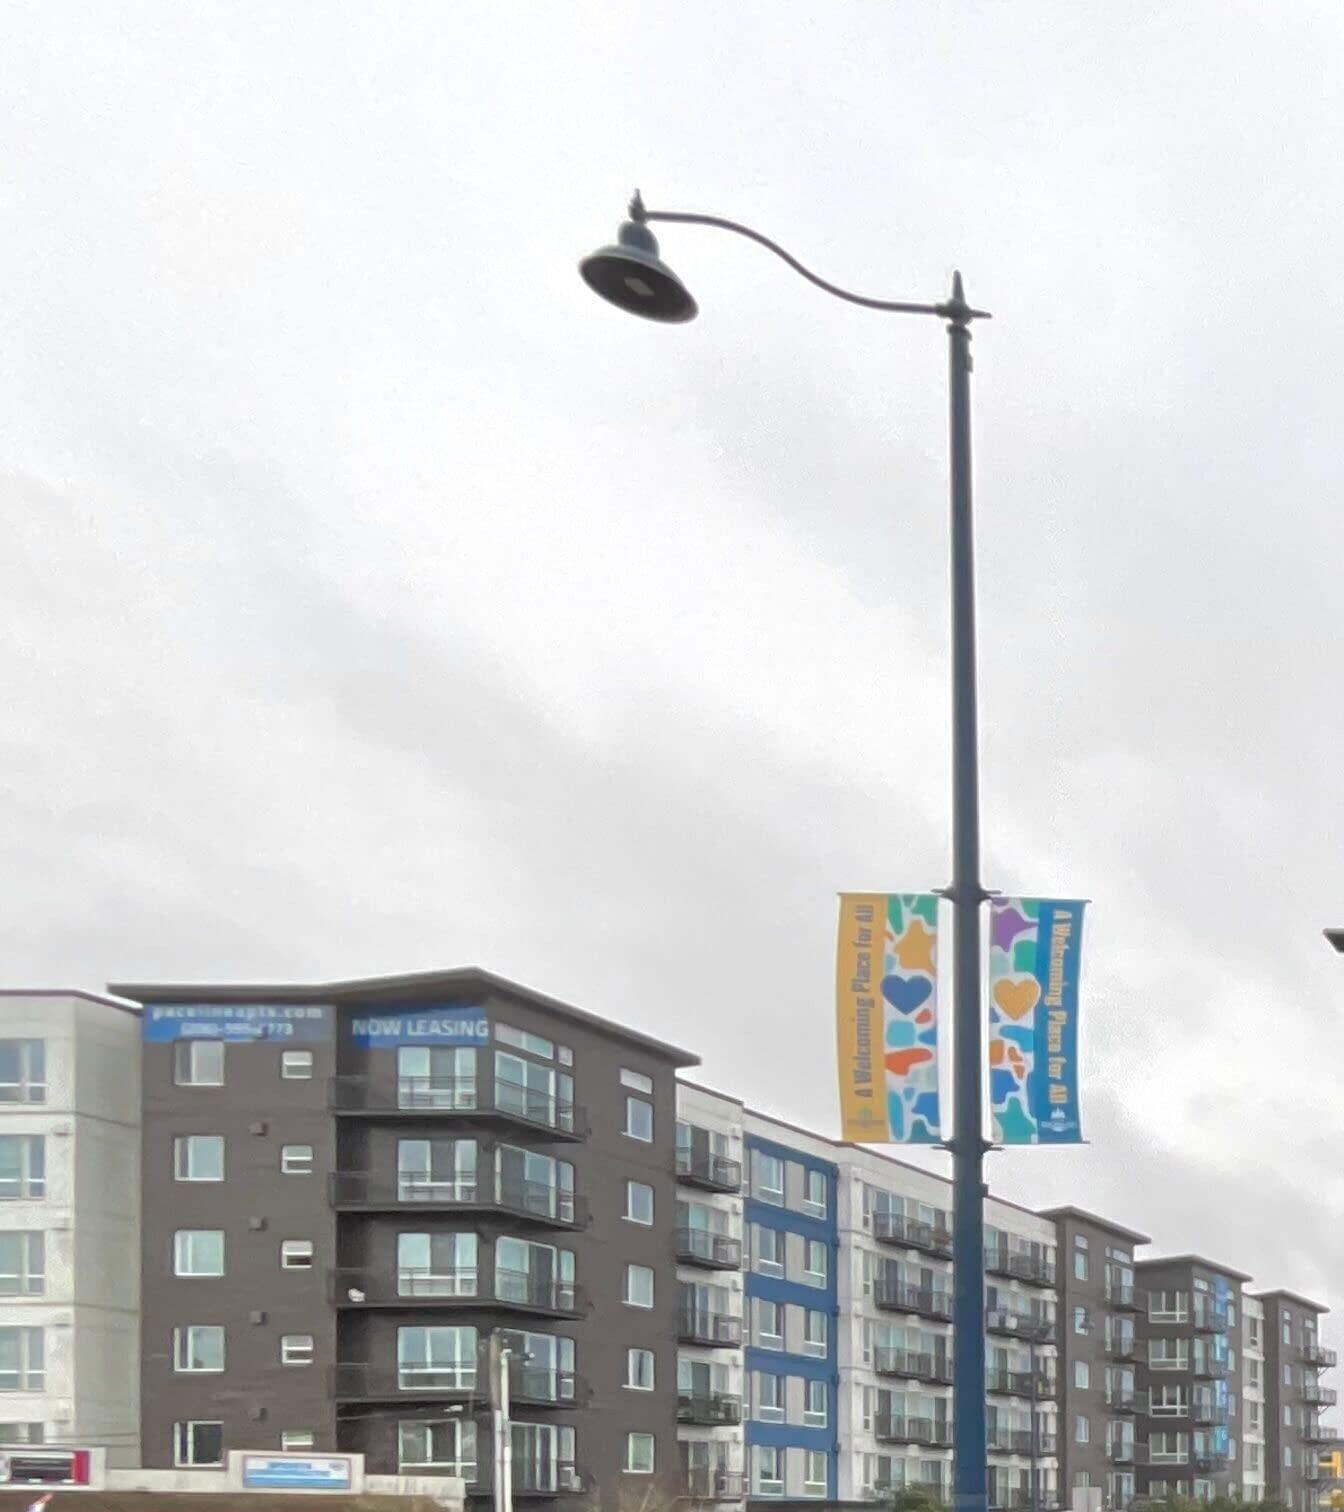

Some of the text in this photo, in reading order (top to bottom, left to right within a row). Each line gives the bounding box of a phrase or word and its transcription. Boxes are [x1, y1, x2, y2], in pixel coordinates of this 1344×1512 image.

[853, 926, 872, 947] for
[851, 952, 871, 992] Place
[1044, 923, 1072, 1006] Welcoming
[352, 1017, 489, 1037] NOW LEASING
[853, 997, 875, 1084] Welcoming
[1048, 1011, 1068, 1052] Place
[1048, 1056, 1067, 1079] for
[1049, 1084, 1068, 1103] All
